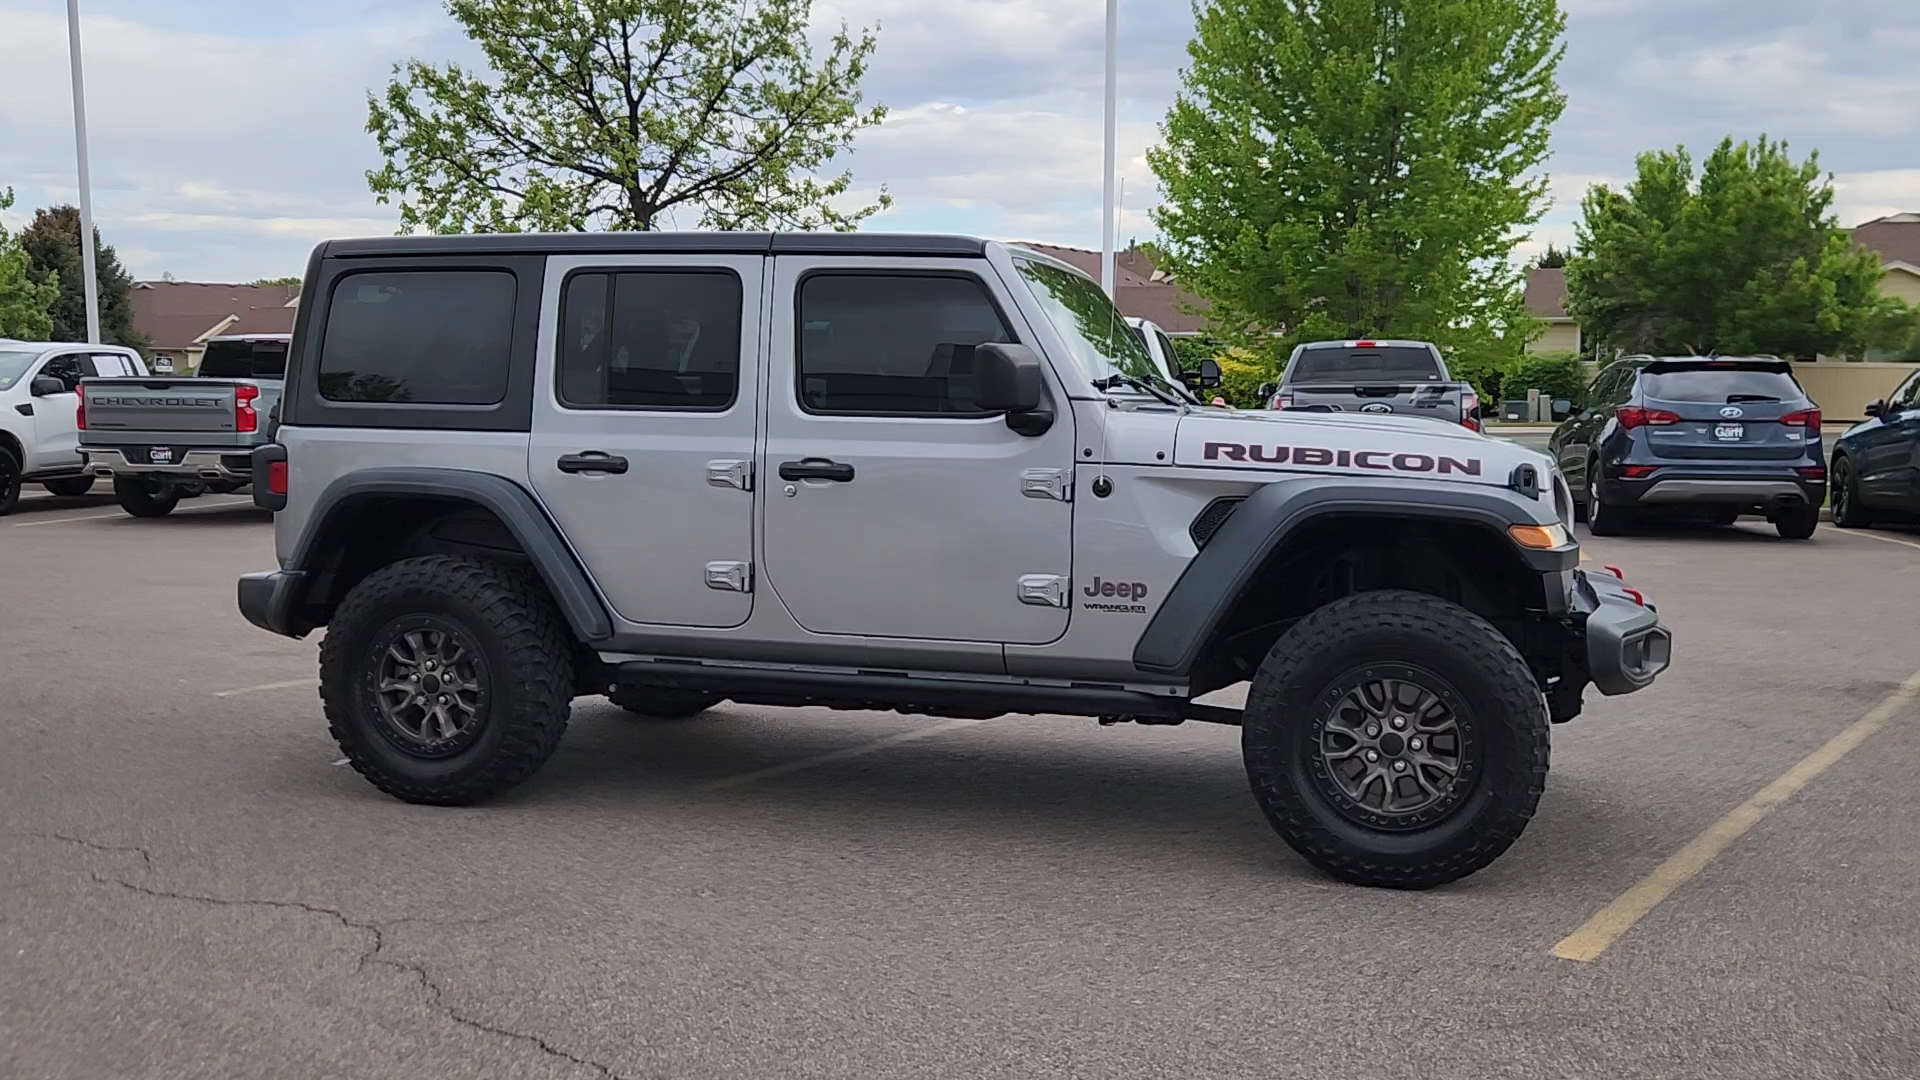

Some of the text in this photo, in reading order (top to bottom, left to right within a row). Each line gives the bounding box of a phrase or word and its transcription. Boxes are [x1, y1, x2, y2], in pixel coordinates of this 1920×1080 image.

[92, 397, 223, 407] CHEVROLET
[1203, 441, 1482, 477] RUBICON
[1083, 576, 1148, 602] Jeep
[1083, 602, 1146, 611] WRANGLER
